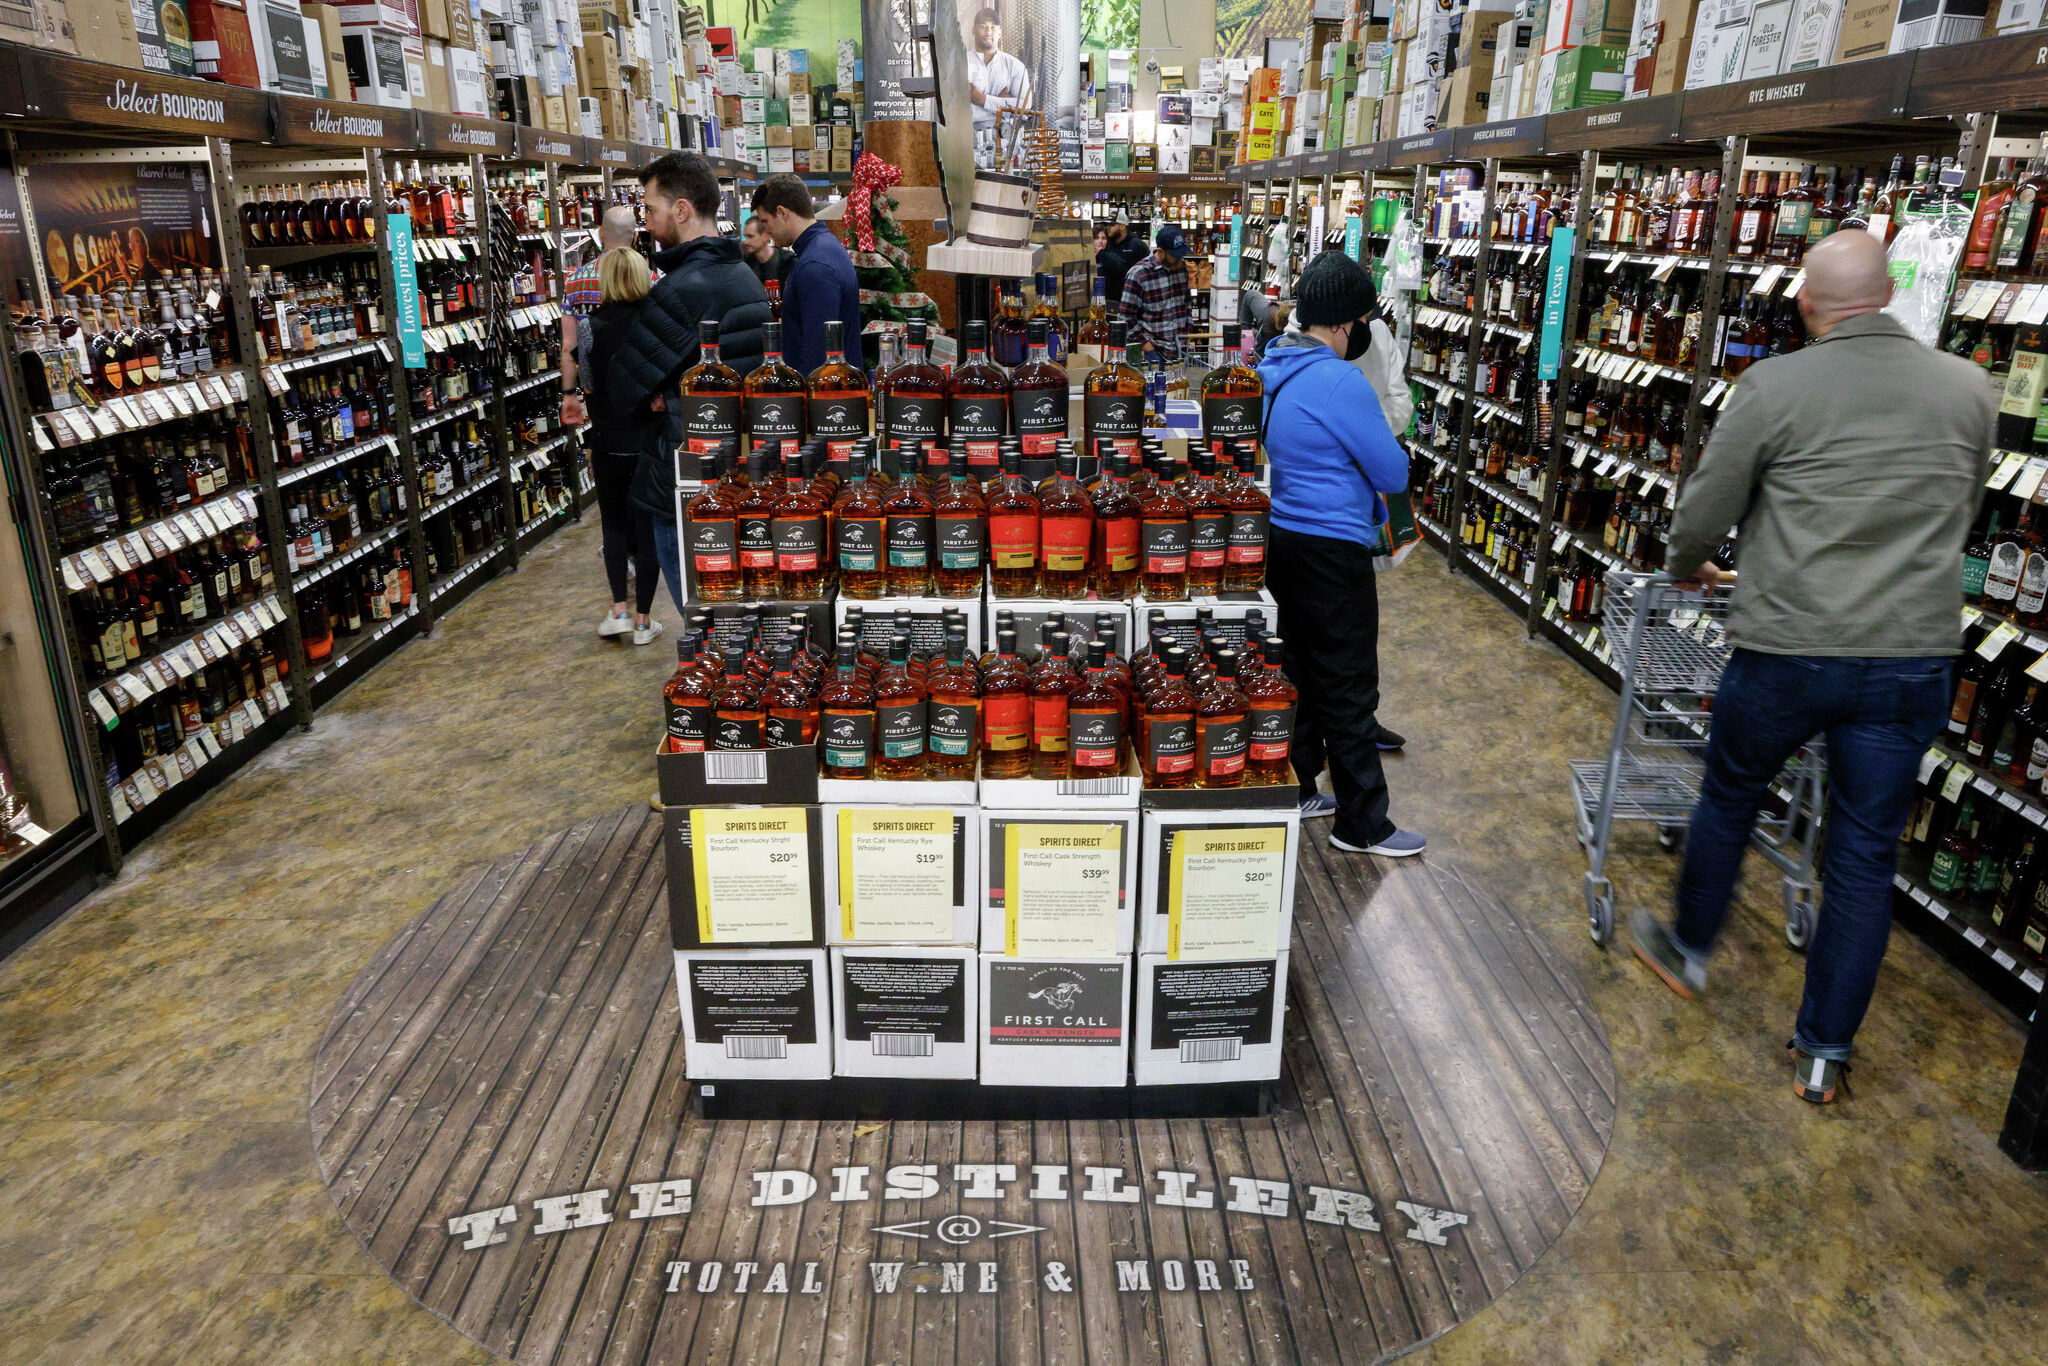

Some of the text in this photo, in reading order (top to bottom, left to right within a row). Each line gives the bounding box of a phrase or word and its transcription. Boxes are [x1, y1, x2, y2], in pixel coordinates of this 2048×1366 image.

[1762, 23, 1774, 34] OLD
[1751, 30, 1782, 48] FORESTER
[1556, 72, 1576, 86] TINCUP
[1749, 82, 1806, 104] RYE WHISKEY
[106, 79, 224, 124] Select BOURBON
[874, 100, 924, 108] everyone ese,
[1260, 110, 1273, 118] CATC
[310, 108, 383, 138] Select BOURBON
[1586, 112, 1622, 126] RYE WHISKEY
[448, 123, 496, 146] Select BOURBON
[1473, 127, 1516, 141] AMERICAN WHISKEY
[536, 136, 571, 156] Select BOURBON
[1402, 138, 1434, 150] AMERICAN WHISKEY
[136, 165, 164, 180] Barrel
[1348, 228, 1357, 258] prices
[396, 232, 416, 334] Lowest prices
[1545, 265, 1564, 325] in Texas
[2018, 354, 2037, 363] DEVIL'S
[2017, 362, 2034, 370] SHARE
[1023, 416, 1064, 425] FIRST CALL
[688, 422, 732, 430] FIRST CALL
[778, 423, 796, 431] CALL
[817, 424, 861, 432] FIRST CALL
[915, 424, 935, 432] CALL
[954, 424, 974, 432] FIRST
[1096, 422, 1138, 430] FIRST CALL
[1213, 423, 1256, 432] FIRST CALL
[1064, 616, 1090, 632] THE POST
[670, 726, 683, 734] FIRST
[931, 724, 948, 732] FIRST
[716, 740, 732, 748] FIRST
[1180, 740, 1195, 748] CALL
[726, 822, 786, 832] SPIRITS DIRECT
[873, 822, 934, 831] SPIRITS DIRECT
[740, 838, 769, 846] Kentucky
[888, 838, 918, 846] Kentucky
[1040, 838, 1101, 846] SPIRITS DIRECT
[1204, 841, 1265, 852] SPIRITS DIRECT
[1072, 853, 1101, 861] Strength
[1024, 860, 1052, 868] Whiskey
[1034, 969, 1048, 978] CALL
[1072, 971, 1086, 982] POST
[1004, 1016, 1108, 1026] FIRST CALL
[448, 1164, 1468, 1250] THE DISTILLERY
[665, 1258, 1255, 1294] TOTAL WNE & MORE
